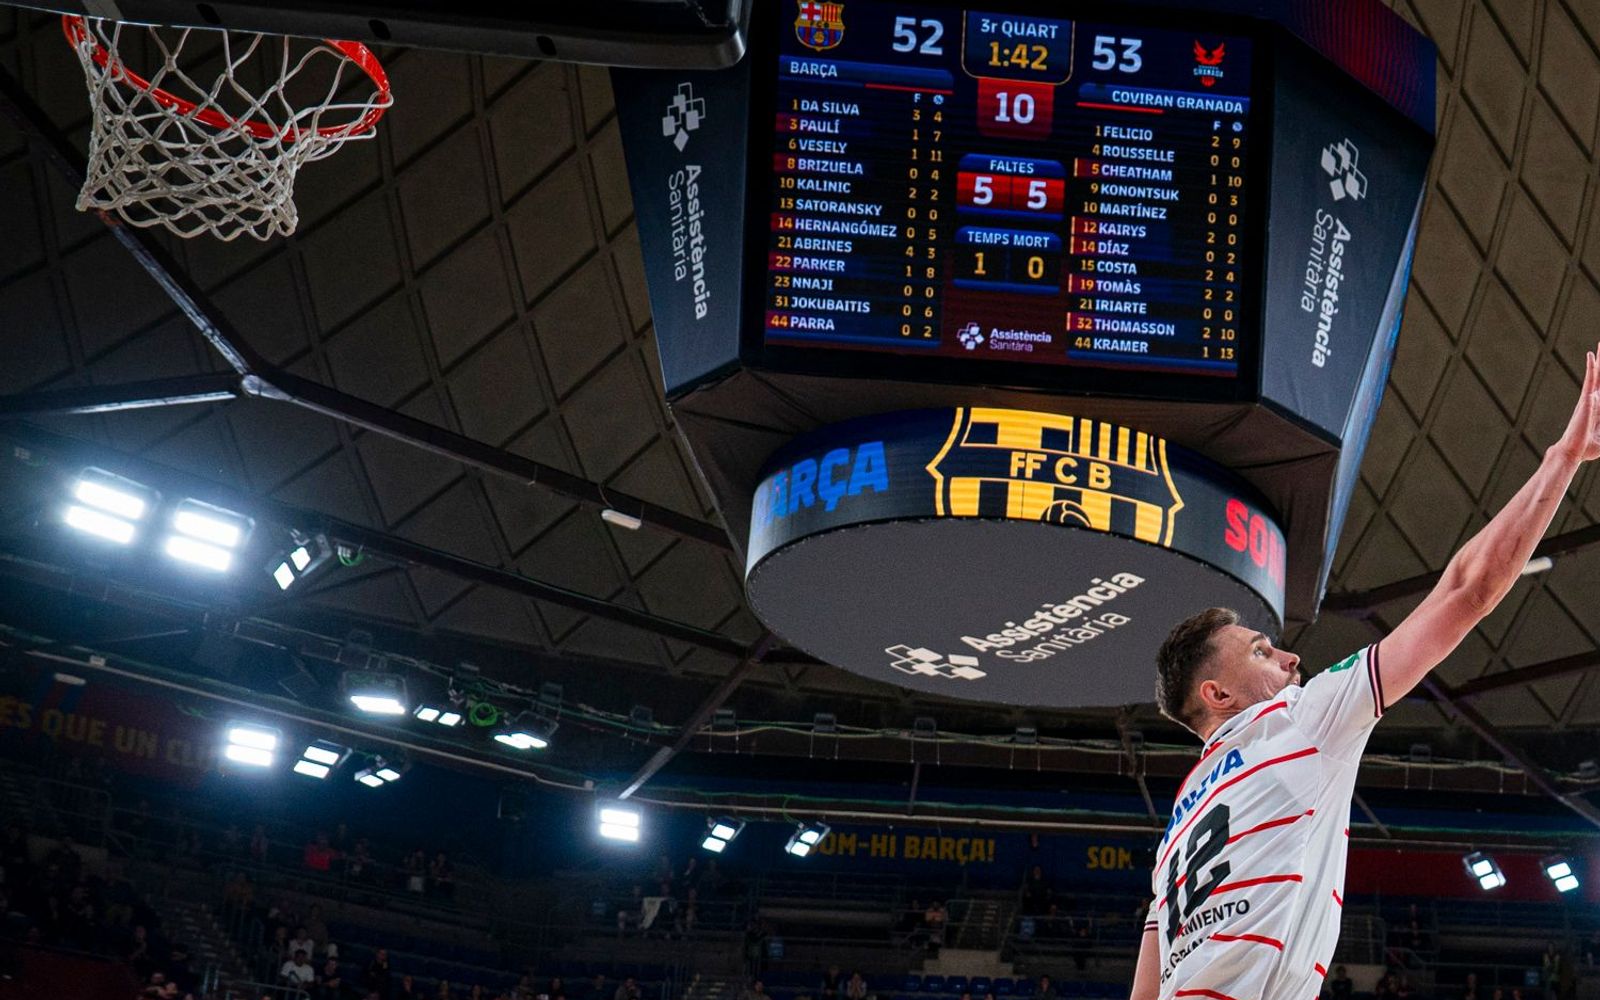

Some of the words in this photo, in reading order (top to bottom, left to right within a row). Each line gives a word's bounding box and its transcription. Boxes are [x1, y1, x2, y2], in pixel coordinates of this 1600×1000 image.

[892, 16, 944, 56] 52
[981, 19, 998, 33] 3r
[1001, 20, 1059, 39] QUART
[988, 41, 1048, 71] 1:42
[1092, 35, 1143, 73] 53
[790, 61, 838, 78] BARÇA
[793, 100, 798, 109] 1
[801, 100, 819, 111] DA
[822, 102, 860, 116] SILVA
[913, 110, 920, 120] 3
[934, 111, 942, 122] 4
[994, 92, 1035, 124] 10
[1112, 90, 1173, 107] COVIRAN
[1177, 96, 1243, 114] GRANADA
[790, 119, 797, 130] 3
[800, 119, 840, 134] PAULÍ
[913, 129, 918, 140] 1
[934, 131, 941, 142] 7
[1096, 126, 1101, 136] 1
[1103, 126, 1152, 141] FELICIO
[1212, 136, 1219, 147] 2
[1233, 138, 1240, 148] 9
[789, 139, 796, 149] 6
[799, 139, 847, 153] VESELY
[912, 149, 917, 159] 1
[931, 151, 942, 161] 11
[1092, 145, 1100, 155] 4
[1102, 145, 1175, 162] ROUSSELLE
[787, 158, 795, 169] 8
[798, 159, 863, 175] BRIZUELA
[931, 170, 939, 180] 4
[990, 159, 1034, 174] FALTES
[1092, 163, 1099, 174] 5
[1101, 164, 1172, 181] CHEATHAM
[1211, 174, 1216, 185] 1
[1228, 176, 1242, 187] 10
[780, 178, 794, 188] 10
[797, 179, 851, 193] KALINIC
[910, 188, 916, 199] 2
[931, 189, 938, 200] 2
[973, 176, 993, 205] 5
[1027, 180, 1047, 210] 5
[1090, 183, 1098, 193] 9
[1101, 184, 1179, 200] KONONTSUK
[1230, 195, 1237, 206] 3
[780, 198, 793, 208] 13
[796, 199, 882, 216] SATORANSKY
[1084, 202, 1097, 212] 10
[1100, 203, 1167, 219] MARTÍNEZ
[1229, 214, 1237, 225] 0
[668, 169, 688, 282] Sanitària
[778, 218, 792, 228] 14
[795, 219, 897, 237] HERNANGÓMEZ
[929, 229, 936, 240] 5
[1084, 222, 1097, 233] 12
[1099, 222, 1146, 237] KAIRYS
[1207, 232, 1215, 243] 2
[1228, 234, 1236, 245] 0
[685, 164, 711, 320] Assistència
[778, 237, 791, 248] 21
[794, 238, 852, 252] ABRINES
[906, 246, 914, 257] 4
[928, 248, 935, 259] 3
[968, 231, 1009, 245] TEMPS
[1013, 234, 1050, 248] MORT
[1082, 241, 1095, 252] 14
[1098, 240, 1129, 255] DÍAZ
[1206, 251, 1214, 262] 0
[1228, 253, 1235, 264] 2
[1301, 208, 1334, 313] Sanitària
[776, 256, 790, 268] 22
[794, 257, 845, 272] PARKER
[906, 266, 912, 276] 1
[926, 267, 934, 278] 8
[974, 252, 986, 275] 1
[1028, 255, 1044, 279] 0
[1081, 260, 1094, 270] 15
[1097, 261, 1137, 274] COSTA
[1206, 270, 1213, 281] 2
[1226, 272, 1234, 282] 4
[775, 276, 790, 287] 23
[792, 277, 833, 290] NNAJI
[1081, 279, 1094, 290] 19
[1096, 279, 1141, 294] TOMÀS
[1205, 289, 1212, 299] 2
[1226, 291, 1233, 301] 2
[1311, 218, 1351, 368] Assistència
[776, 296, 788, 307] 31
[791, 297, 870, 313] JOKUBAITIS
[925, 307, 933, 317] 6
[1080, 299, 1092, 309] 21
[1095, 300, 1147, 314] IRIARTE
[1203, 308, 1212, 319] 0
[1225, 310, 1233, 320] 0
[771, 315, 788, 327] 44
[790, 317, 835, 331] PARRA
[924, 326, 932, 337] 2
[990, 328, 1052, 343] Assistència
[1078, 318, 1092, 329] 32
[1094, 318, 1175, 336] THOMASSON
[1203, 328, 1210, 338] 2
[1221, 329, 1234, 340] 10
[1075, 337, 1090, 348] 44
[1094, 338, 1148, 352] KRAMER
[1203, 347, 1208, 358] 1
[1221, 348, 1233, 359] 13
[764, 441, 889, 524] ARÇA
[960, 571, 1145, 654] Assistència
[996, 610, 1131, 666] Sanitària
[41, 707, 107, 746] QUE
[115, 725, 158, 758] UN
[820, 831, 897, 859] OM-HI
[904, 834, 996, 866] BARÇA!
[1165, 803, 1231, 949] 12
